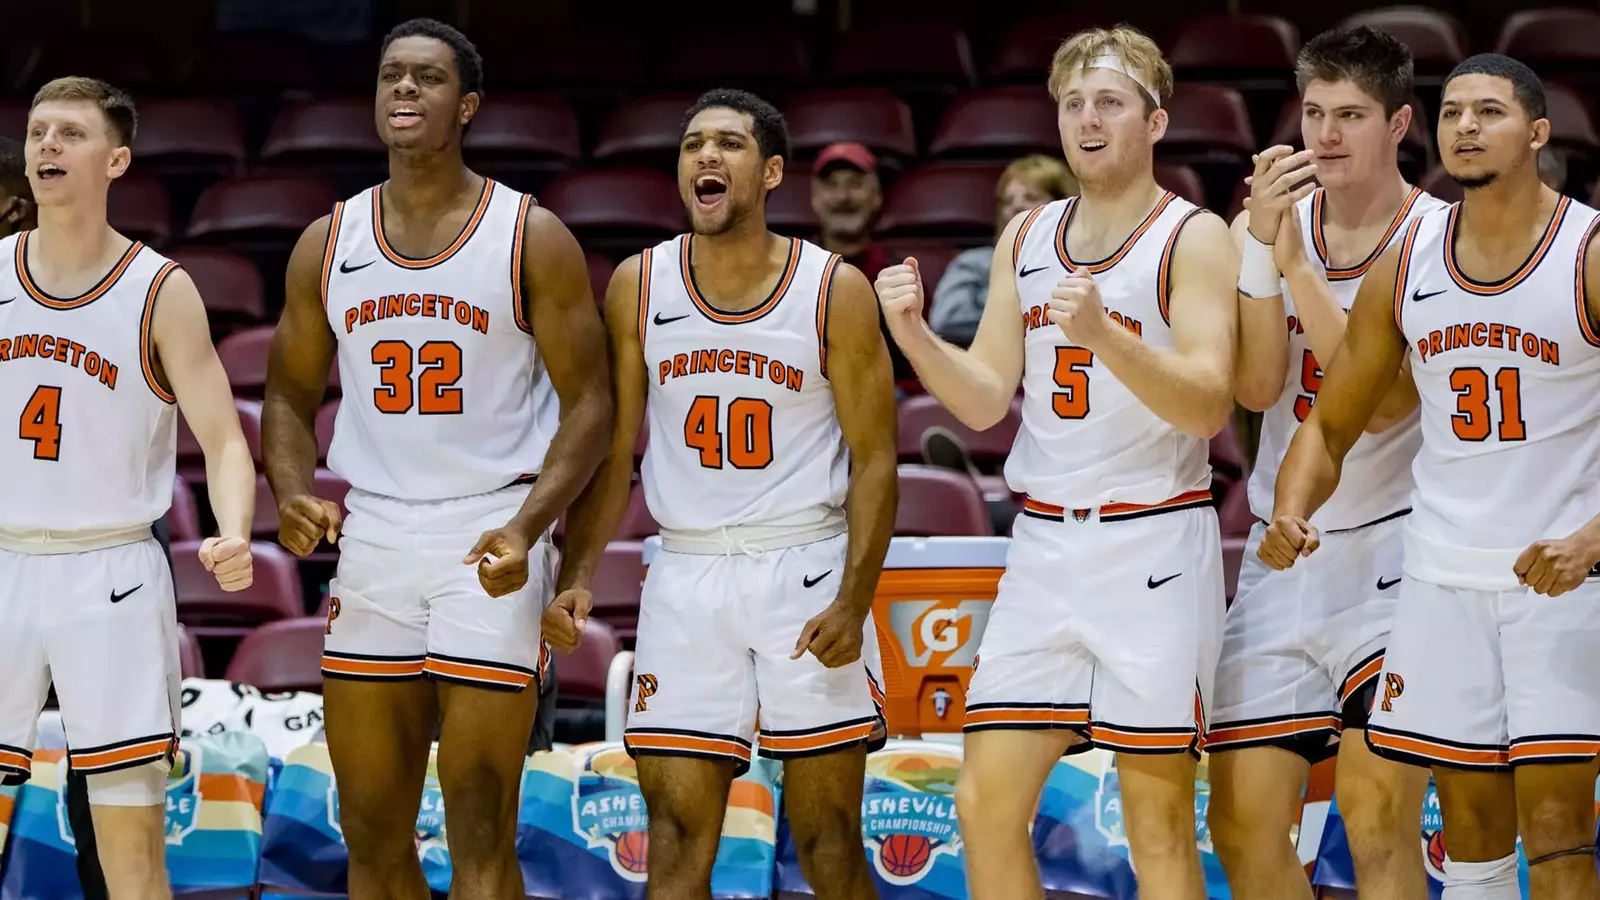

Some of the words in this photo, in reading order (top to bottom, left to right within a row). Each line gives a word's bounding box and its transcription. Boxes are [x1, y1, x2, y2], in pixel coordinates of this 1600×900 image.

[345, 293, 489, 334] PRINCETON
[1023, 303, 1142, 337] PRION
[0, 334, 118, 390] RINCETON
[1417, 322, 1559, 366] PRINCETON
[371, 340, 463, 415] 32
[659, 349, 803, 392] PRINCETON
[1052, 346, 1094, 419] 5
[1293, 348, 1325, 423] 5
[19, 385, 62, 461] 4
[1449, 367, 1526, 441] 31
[684, 395, 773, 470] 40
[921, 608, 958, 652] G
[635, 674, 658, 712] P
[1381, 672, 1405, 711] P
[285, 707, 323, 731] GA
[581, 794, 641, 817] ASHE
[862, 796, 957, 819] SHEVILL
[871, 819, 951, 835] CHAMPIONSHIP
